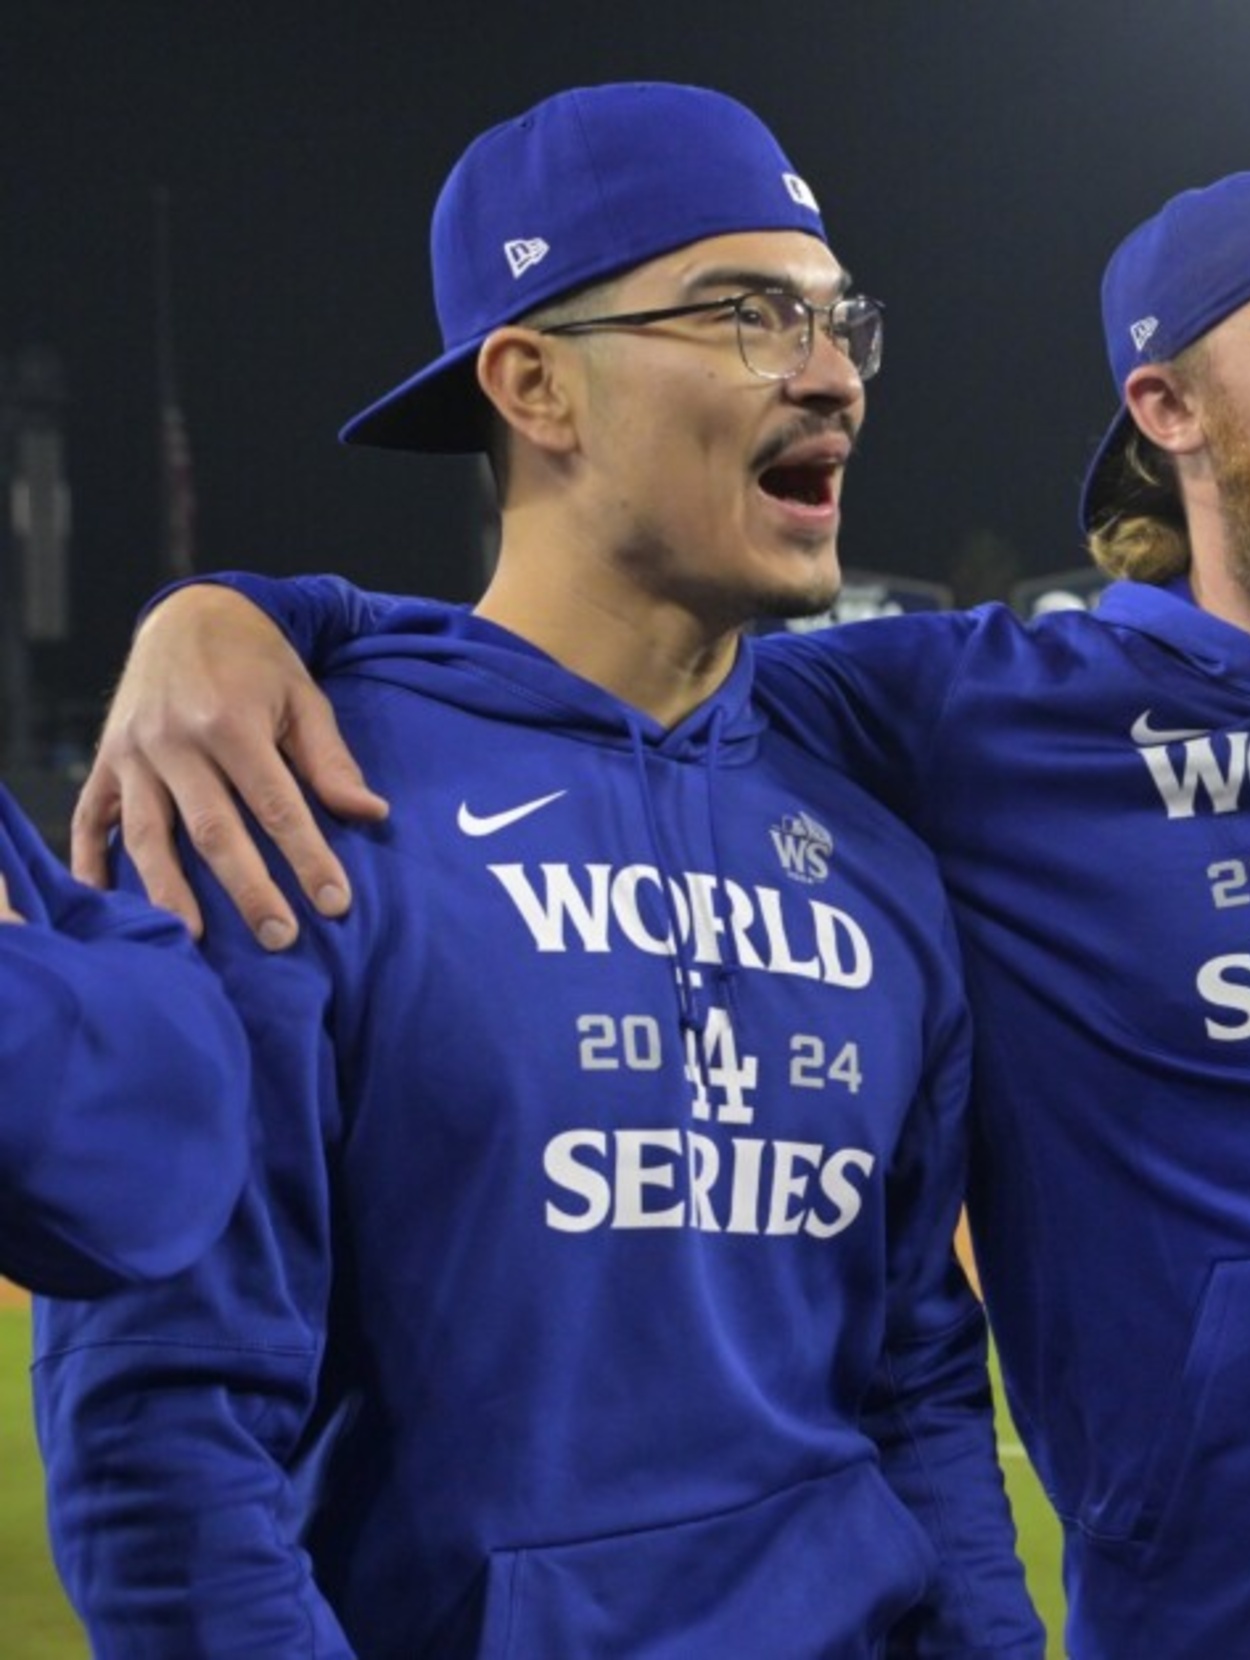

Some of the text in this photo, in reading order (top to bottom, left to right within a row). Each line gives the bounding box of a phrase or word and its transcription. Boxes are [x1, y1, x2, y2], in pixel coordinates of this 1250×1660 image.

[486, 862, 874, 989] WORLD
[576, 1014, 662, 1070] 20
[790, 1034, 863, 1093] 24
[542, 1128, 876, 1239] SERIES
